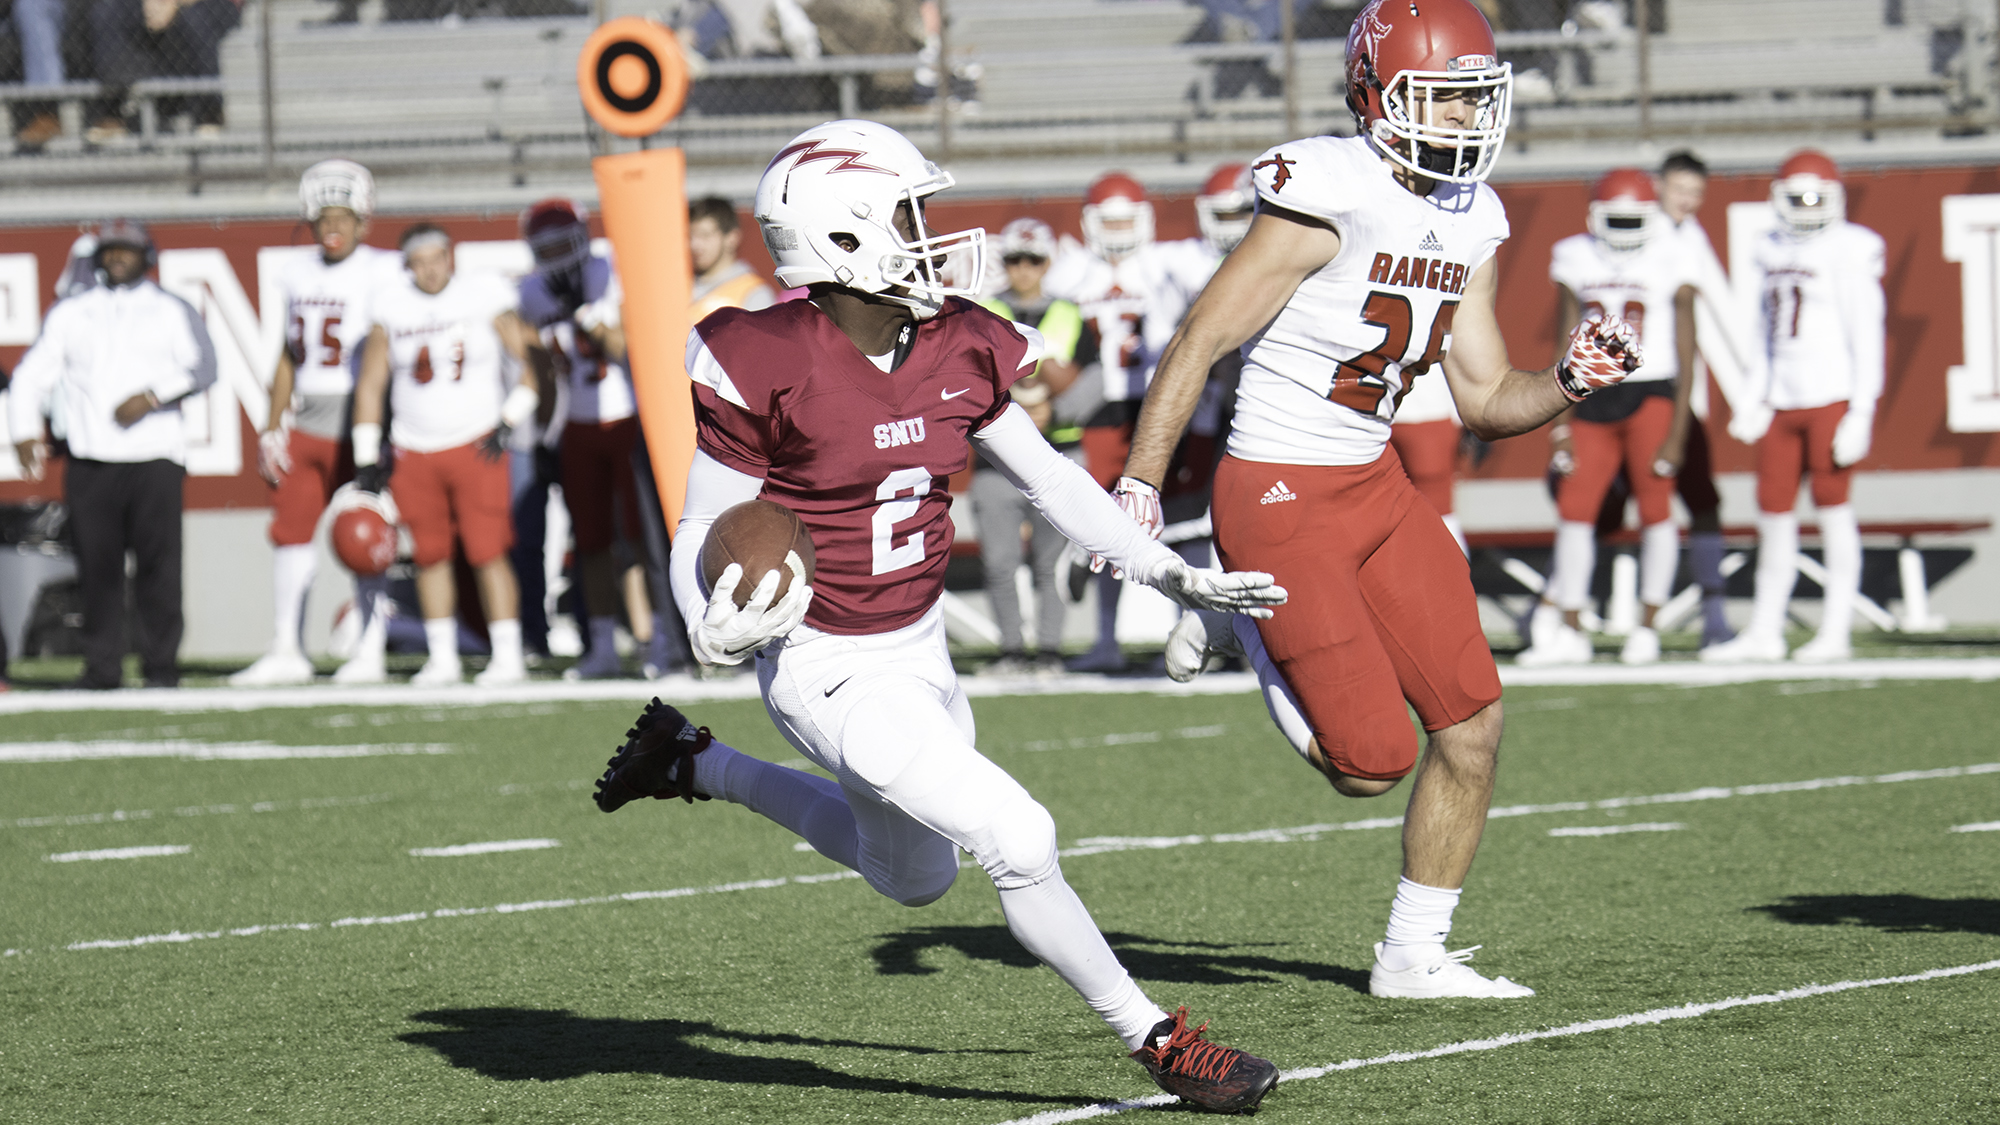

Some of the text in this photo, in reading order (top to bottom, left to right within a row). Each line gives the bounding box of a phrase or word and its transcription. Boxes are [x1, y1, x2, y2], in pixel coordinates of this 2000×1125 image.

[1459, 57, 1484, 67] MTXE
[873, 416, 926, 449] SNU
[1260, 492, 1297, 505] adidas
[871, 466, 933, 576] 2
